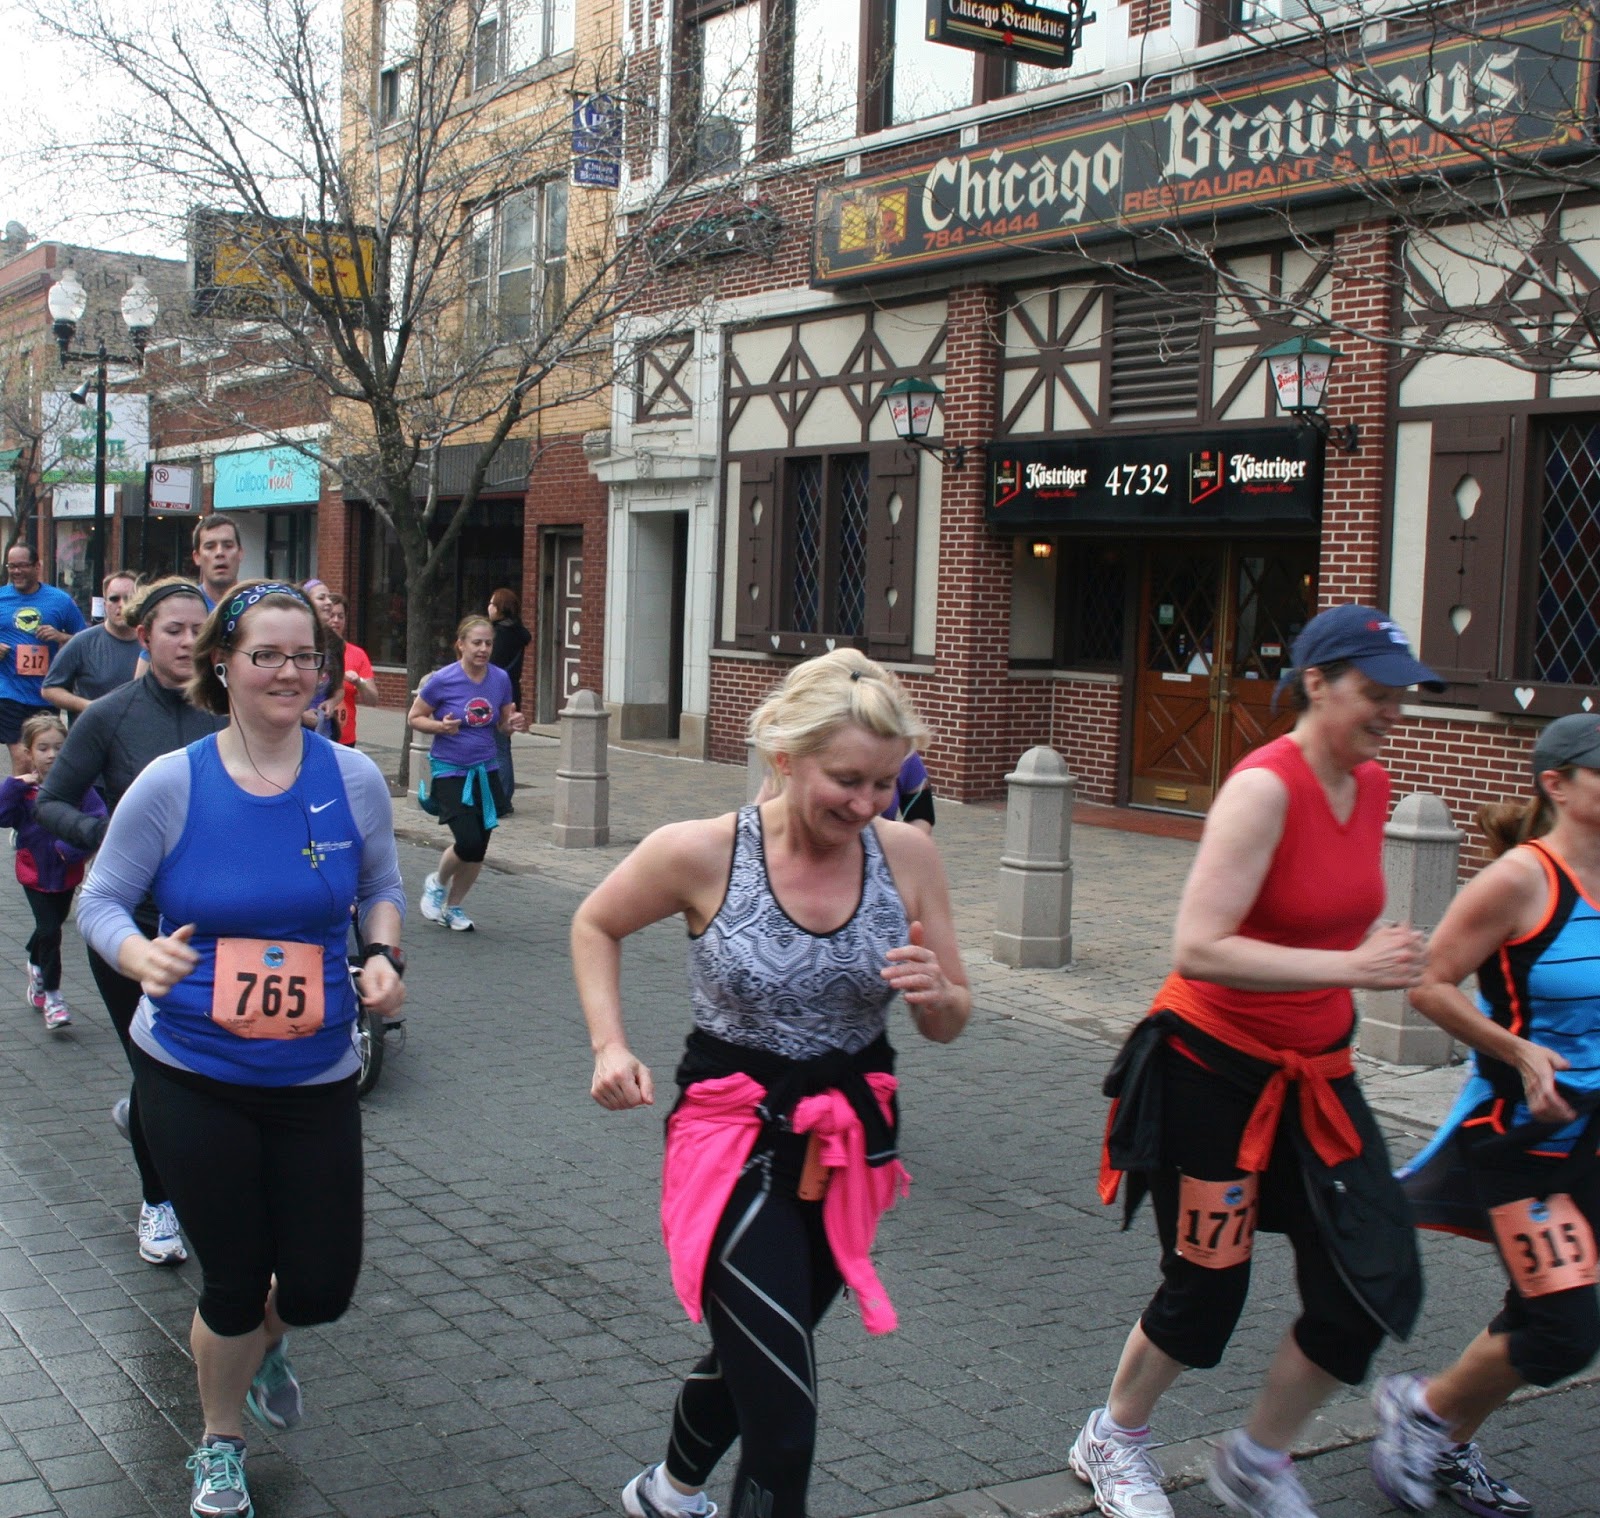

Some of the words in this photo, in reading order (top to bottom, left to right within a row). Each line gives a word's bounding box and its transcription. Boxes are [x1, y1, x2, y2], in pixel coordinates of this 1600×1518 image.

[950, 0, 999, 28] Chicago
[1001, 3, 1065, 38] Brauhaus
[922, 141, 1123, 231] Chicago
[1158, 47, 1520, 184] Brauhaus
[1124, 155, 1322, 212] RESTAURANT
[922, 211, 1040, 250] 784-4444
[1105, 463, 1169, 497] 4732
[23, 655, 44, 669] 217
[236, 972, 306, 1019] 765
[1514, 1223, 1583, 1274] 315
